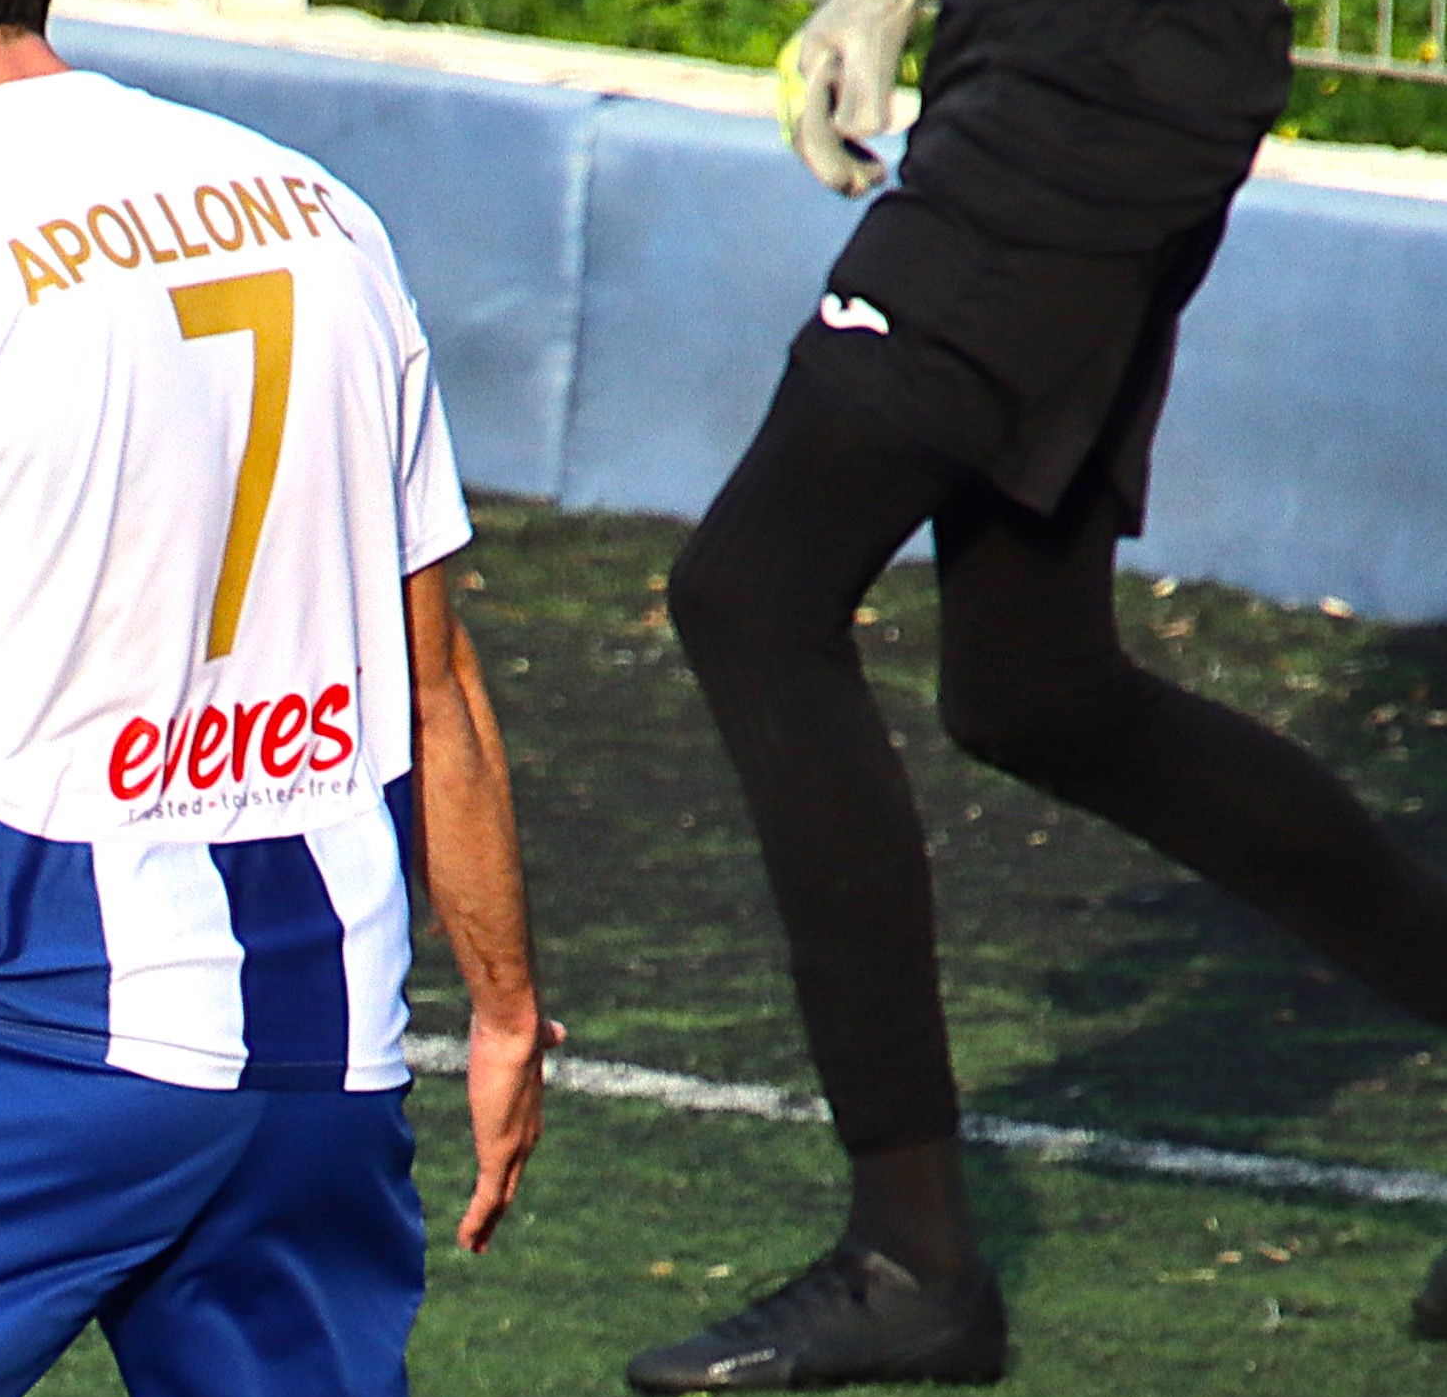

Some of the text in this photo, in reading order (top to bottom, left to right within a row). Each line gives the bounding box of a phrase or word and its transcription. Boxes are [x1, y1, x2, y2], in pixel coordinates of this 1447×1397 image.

[7, 175, 356, 306] APOLLON FC
[168, 267, 295, 663] 7
[108, 683, 355, 801] everes
